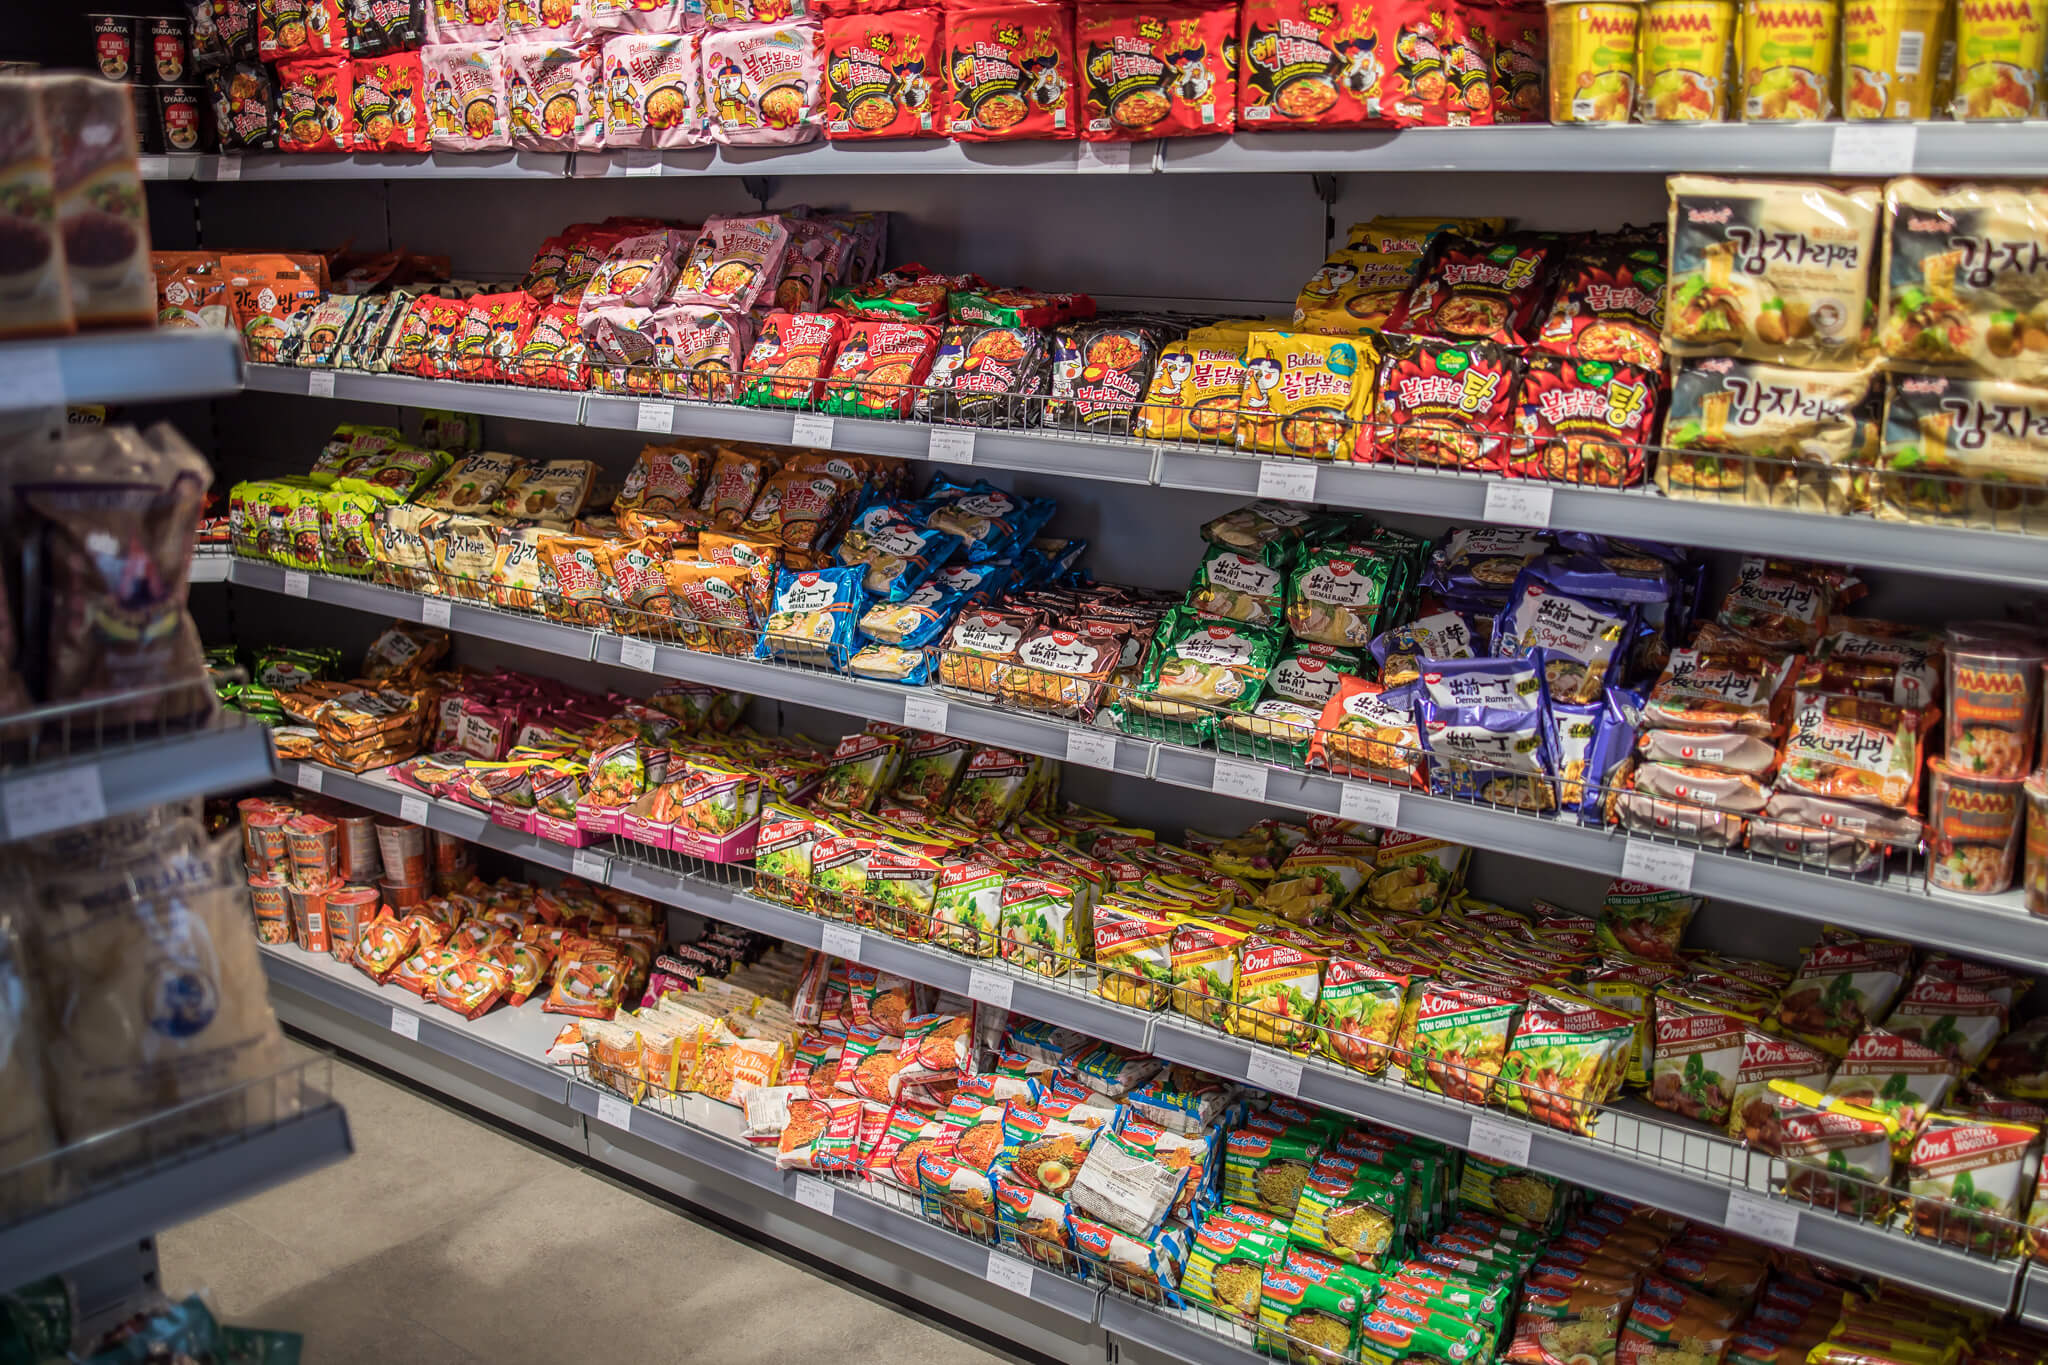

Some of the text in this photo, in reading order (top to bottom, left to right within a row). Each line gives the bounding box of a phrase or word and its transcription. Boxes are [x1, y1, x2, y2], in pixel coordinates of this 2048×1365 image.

[1757, 10, 1824, 28] MAMA
[1964, 1, 2032, 22] MAMA
[1590, 16, 1635, 34] MAM
[1726, 226, 1858, 276] 감자라면
[741, 465, 755, 480] Cur
[827, 462, 855, 479] Curry
[732, 546, 761, 565] Curry
[705, 580, 735, 599] Curry
[1053, 632, 1076, 643] NISSIN
[1090, 626, 1113, 636] NISSIN
[1029, 642, 1089, 666] 出前一丁
[1298, 657, 1325, 669] NISSIN
[1278, 668, 1339, 694] 出前一丁
[1957, 669, 2024, 695] MAMA
[1948, 788, 2014, 814] MAMA
[1273, 955, 1302, 966] NOODLES
[1435, 1018, 1452, 1029] CHUA
[1564, 1012, 1598, 1023] INSTANT
[1564, 1020, 1601, 1031] NOODLES
[1691, 1017, 1725, 1028] INSTANT
[1691, 1024, 1727, 1037] NOODLES
[1531, 1037, 1549, 1047] CHUA
[1848, 1038, 1898, 1058] A-One
[1742, 1044, 1785, 1064] A-One
[1952, 1128, 1993, 1141] INSTANT
[1954, 1134, 1999, 1152] NOODLES
